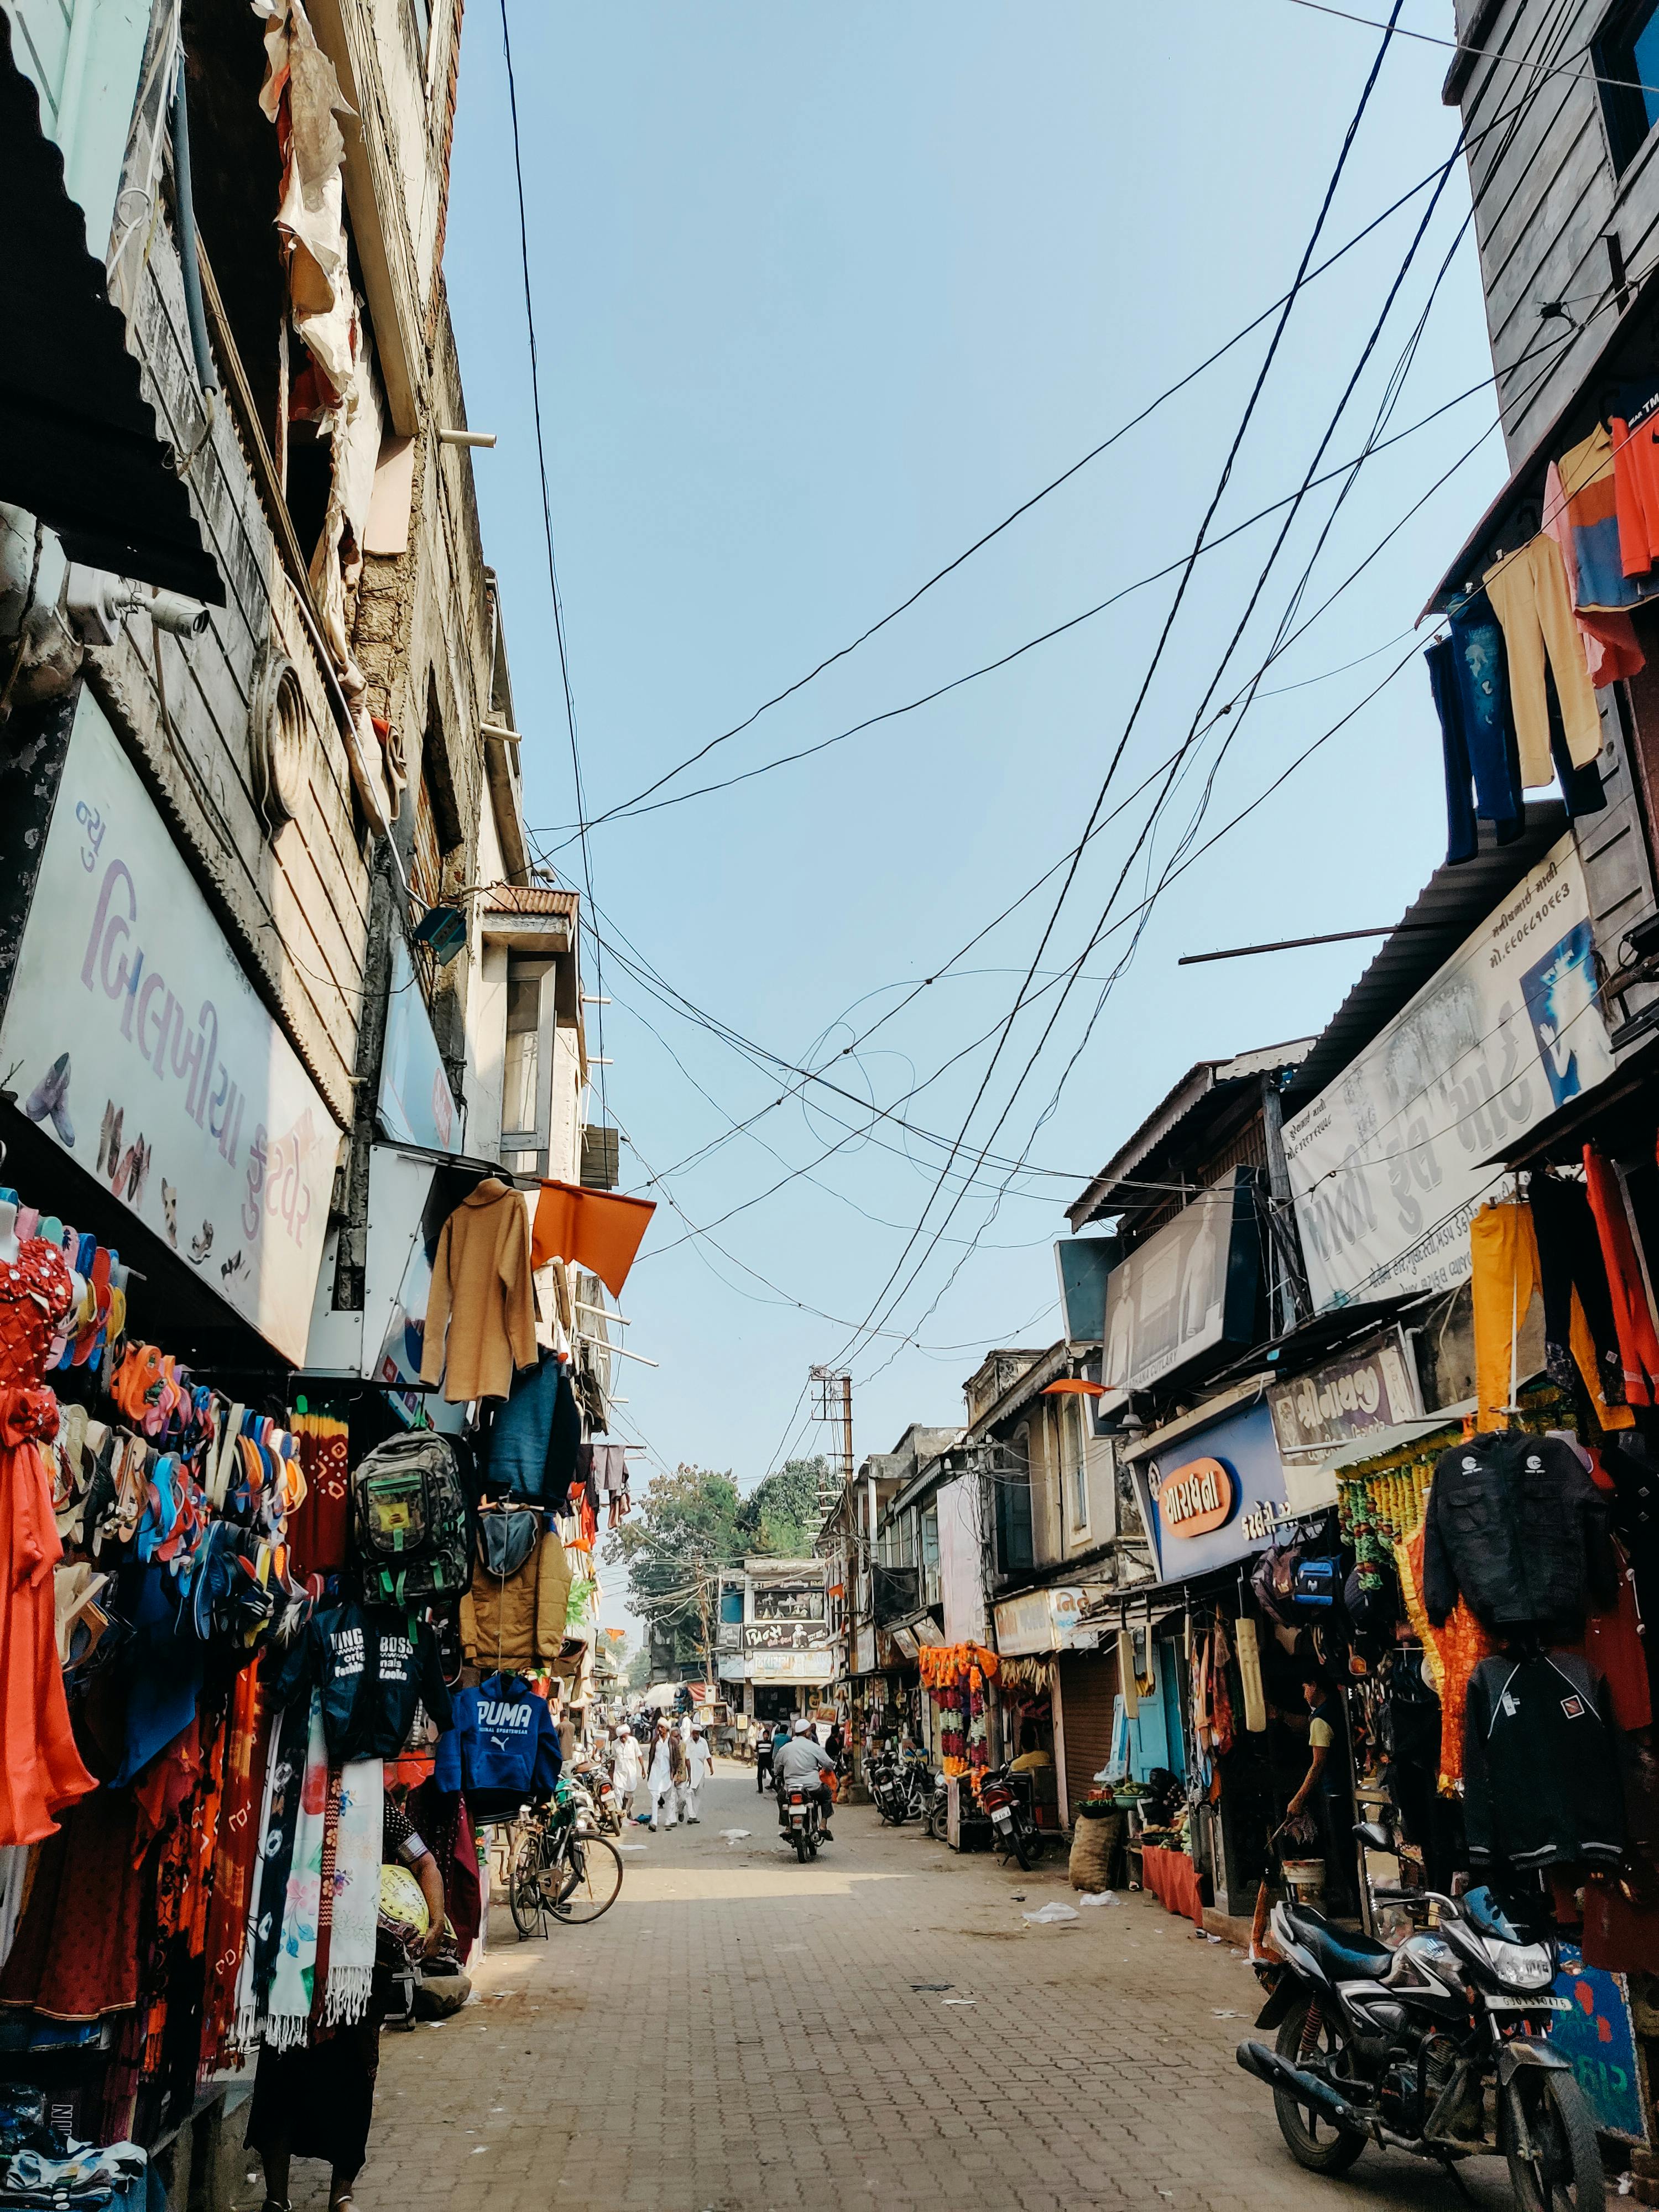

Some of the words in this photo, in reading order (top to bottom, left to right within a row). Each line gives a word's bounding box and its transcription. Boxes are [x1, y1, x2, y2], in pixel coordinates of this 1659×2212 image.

[1163, 1470, 1220, 1525] આરાધના
[379, 1636, 414, 1655] BOSS
[477, 1700, 532, 1728] PUMA
